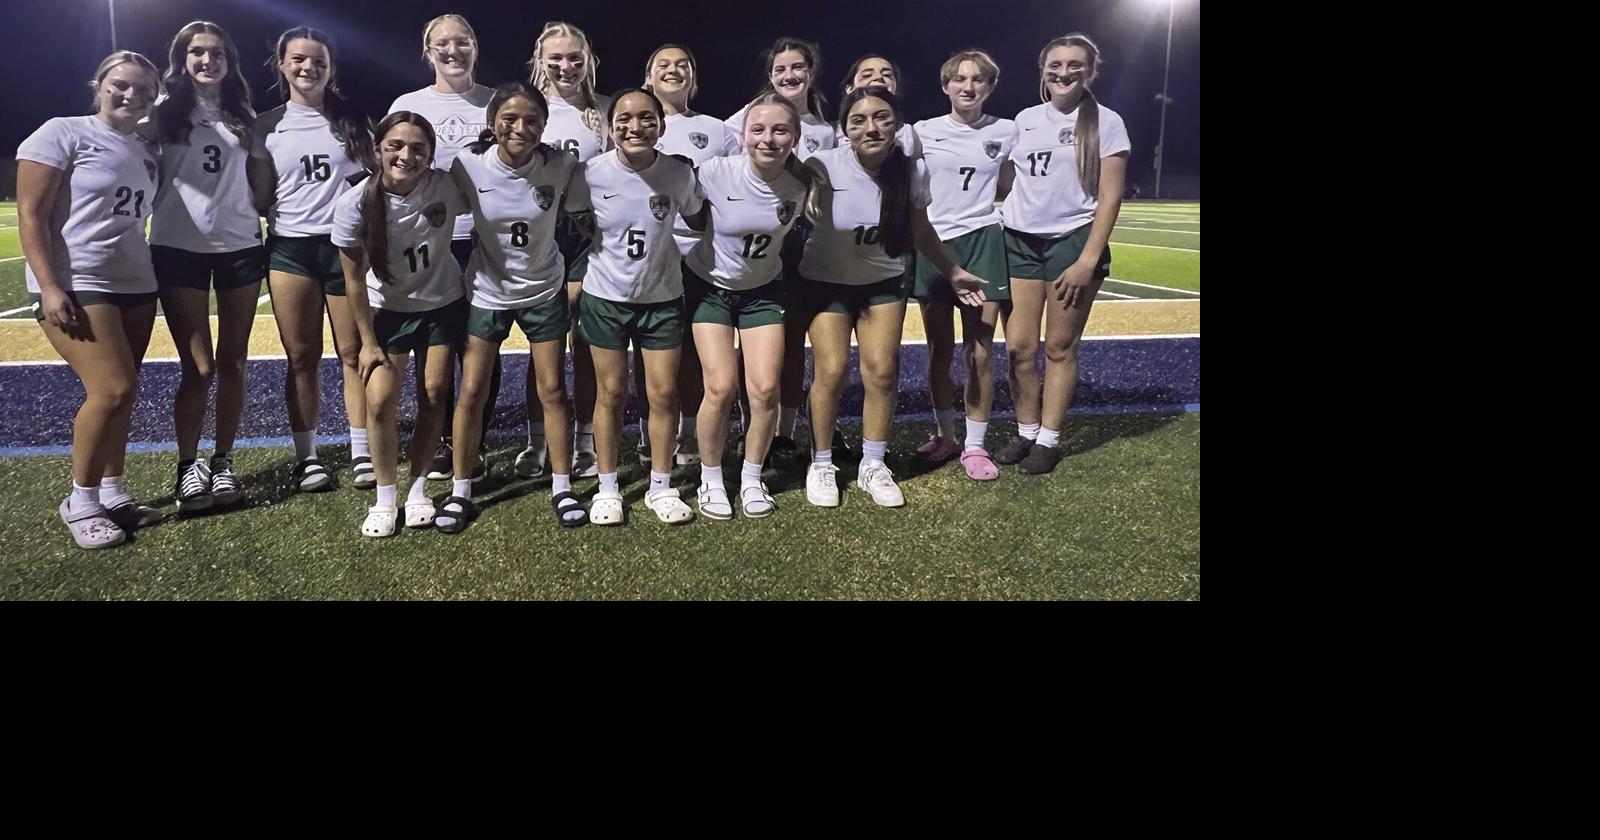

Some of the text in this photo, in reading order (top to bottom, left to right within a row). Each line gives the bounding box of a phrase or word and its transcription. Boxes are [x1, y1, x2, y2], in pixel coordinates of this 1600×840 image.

[203, 145, 221, 173] 3
[300, 153, 330, 181] 15
[1027, 151, 1053, 176] 17
[959, 167, 976, 191] 7
[113, 186, 144, 218] 21
[511, 222, 528, 247] 8
[627, 229, 646, 260] 5
[743, 234, 771, 259] 12
[404, 244, 430, 273] 11
